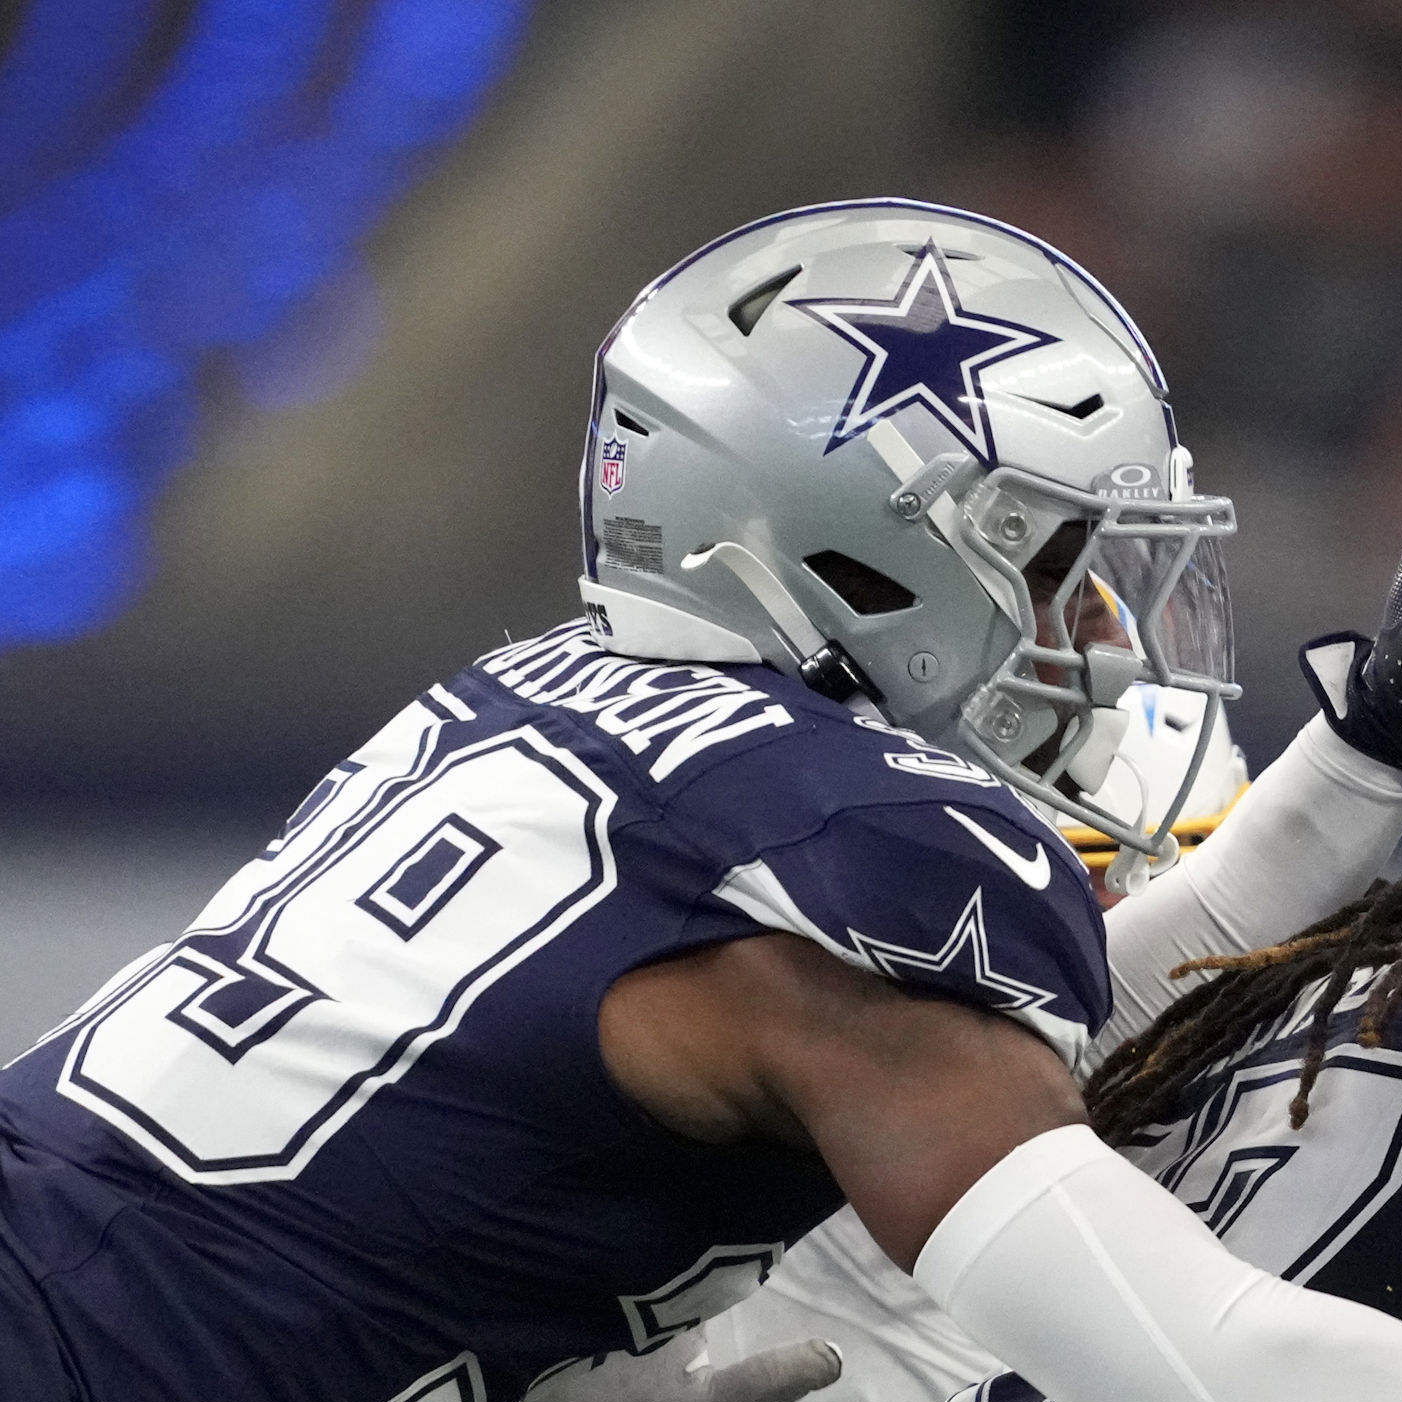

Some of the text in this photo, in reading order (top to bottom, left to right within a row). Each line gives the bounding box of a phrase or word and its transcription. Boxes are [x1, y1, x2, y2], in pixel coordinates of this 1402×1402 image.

[602, 462, 621, 487] NFL
[1099, 487, 1160, 499] OAKLEY
[472, 615, 795, 783] OHNSON
